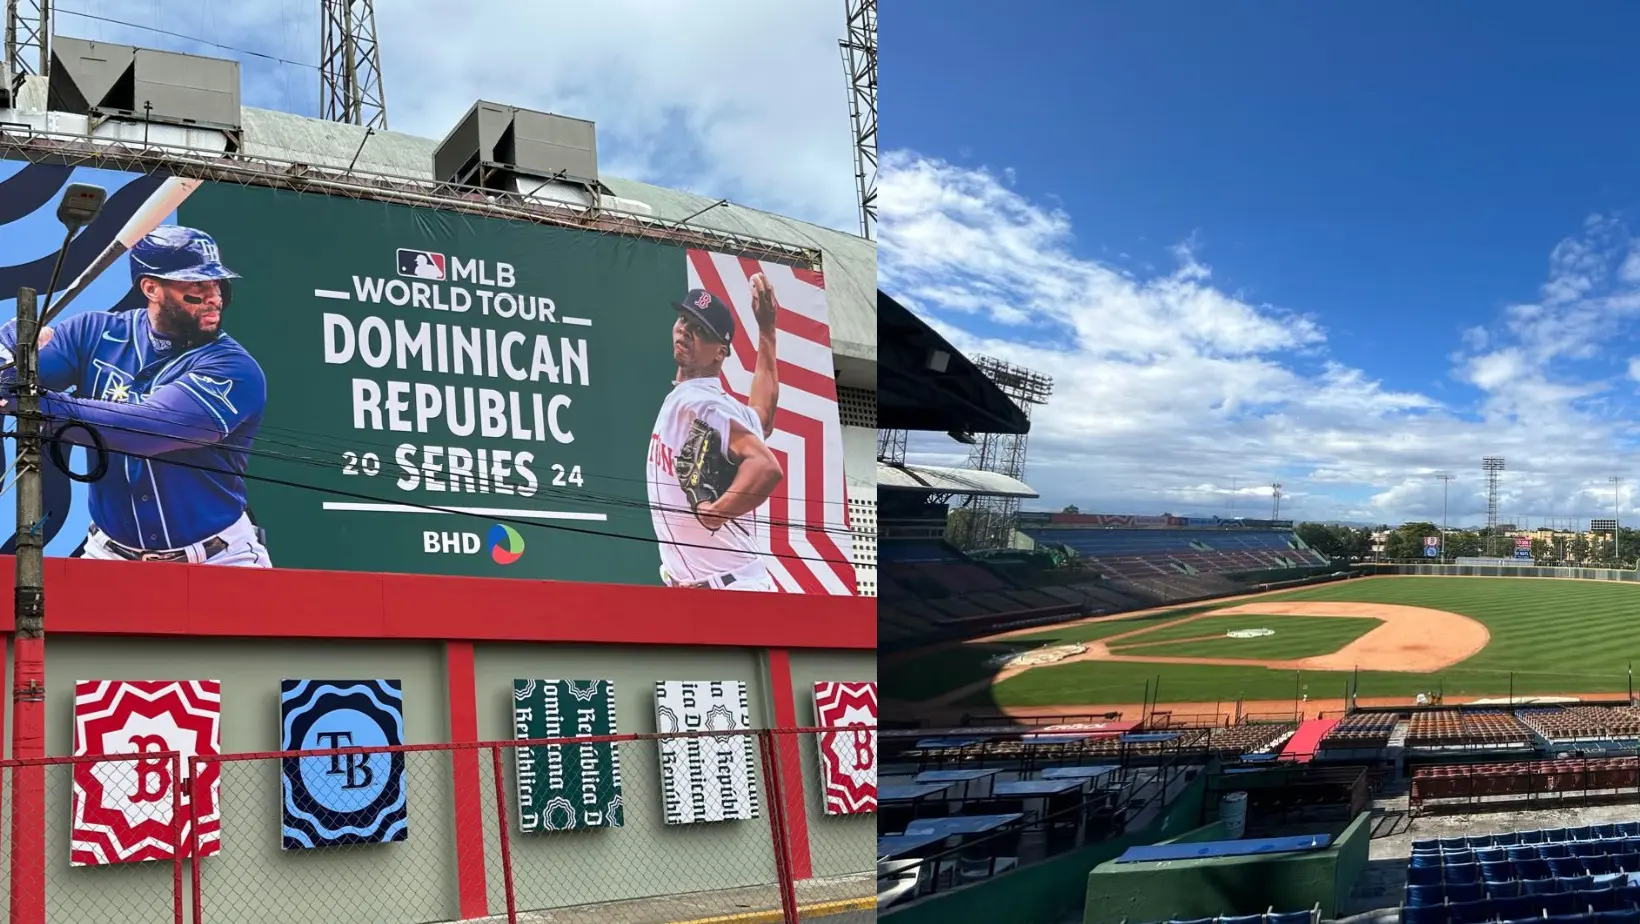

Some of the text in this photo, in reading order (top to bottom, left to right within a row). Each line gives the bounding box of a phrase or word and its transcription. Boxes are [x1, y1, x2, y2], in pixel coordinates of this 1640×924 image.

[352, 275, 556, 323] WORLD TOUR
[451, 256, 516, 288] MLB
[323, 312, 590, 386] DOMINICAN
[352, 378, 575, 444] REPUBLIC
[341, 443, 584, 497] 20 SERIES 24
[423, 531, 481, 555] BHD
[127, 734, 171, 804] B
[316, 731, 376, 791] TB
